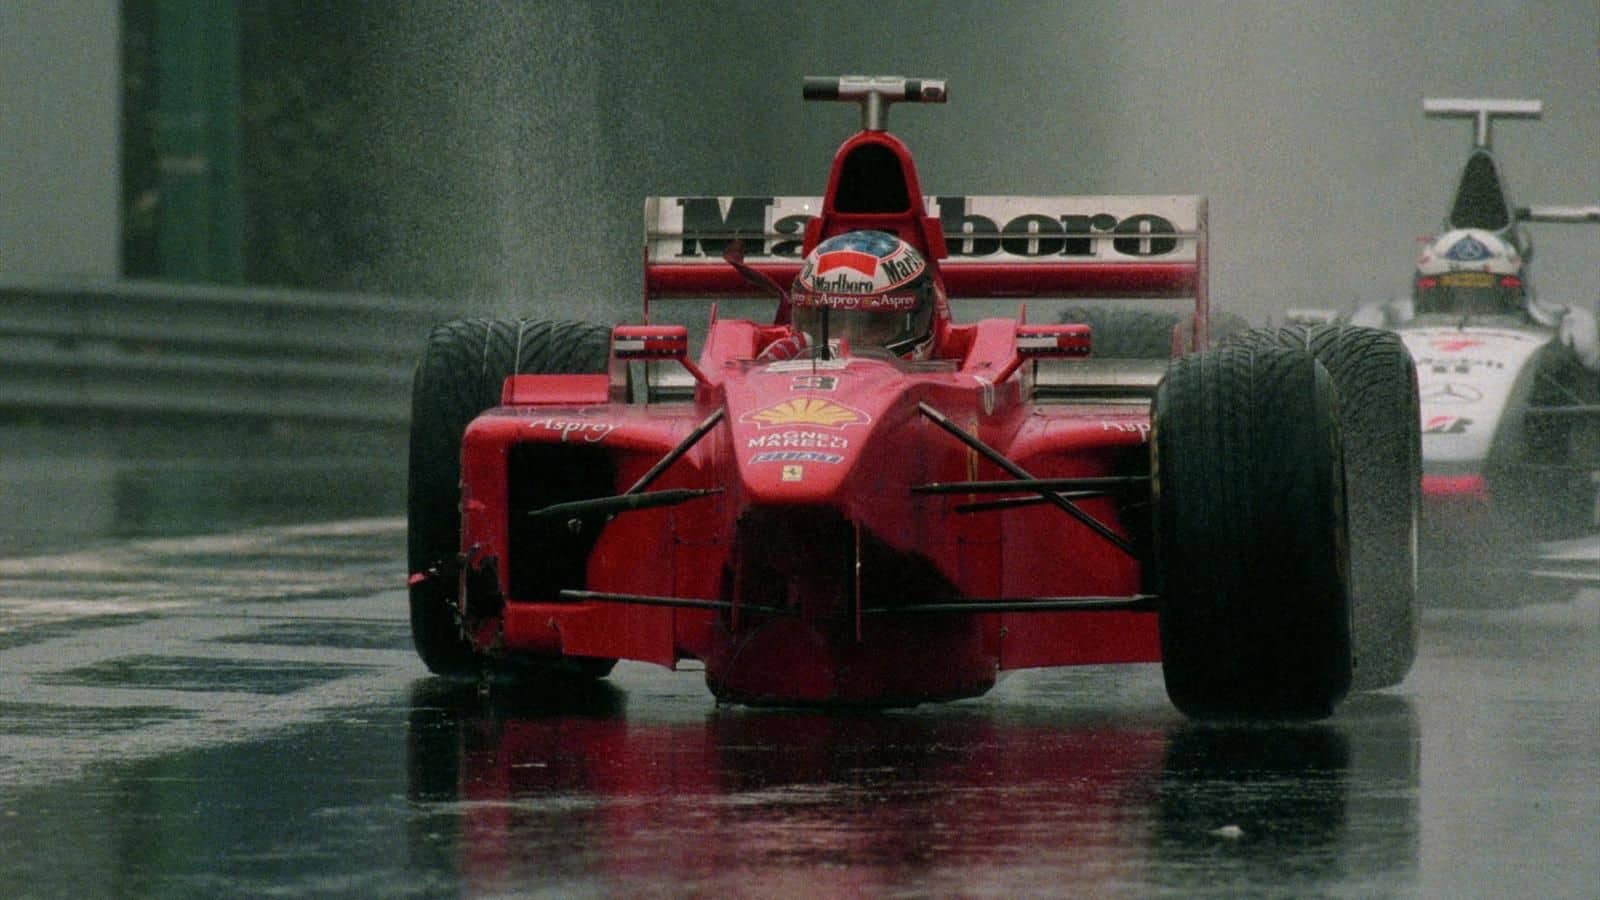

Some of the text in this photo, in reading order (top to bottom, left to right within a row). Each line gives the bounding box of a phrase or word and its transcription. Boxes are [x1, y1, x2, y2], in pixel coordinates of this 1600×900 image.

[674, 197, 1178, 258] Maboro
[812, 273, 874, 293] Marlboro
[820, 293, 861, 309] Asprey
[881, 294, 915, 309] Asprey
[790, 375, 839, 391] 3
[528, 417, 623, 443] Asprey
[748, 436, 848, 448] MARELLI
